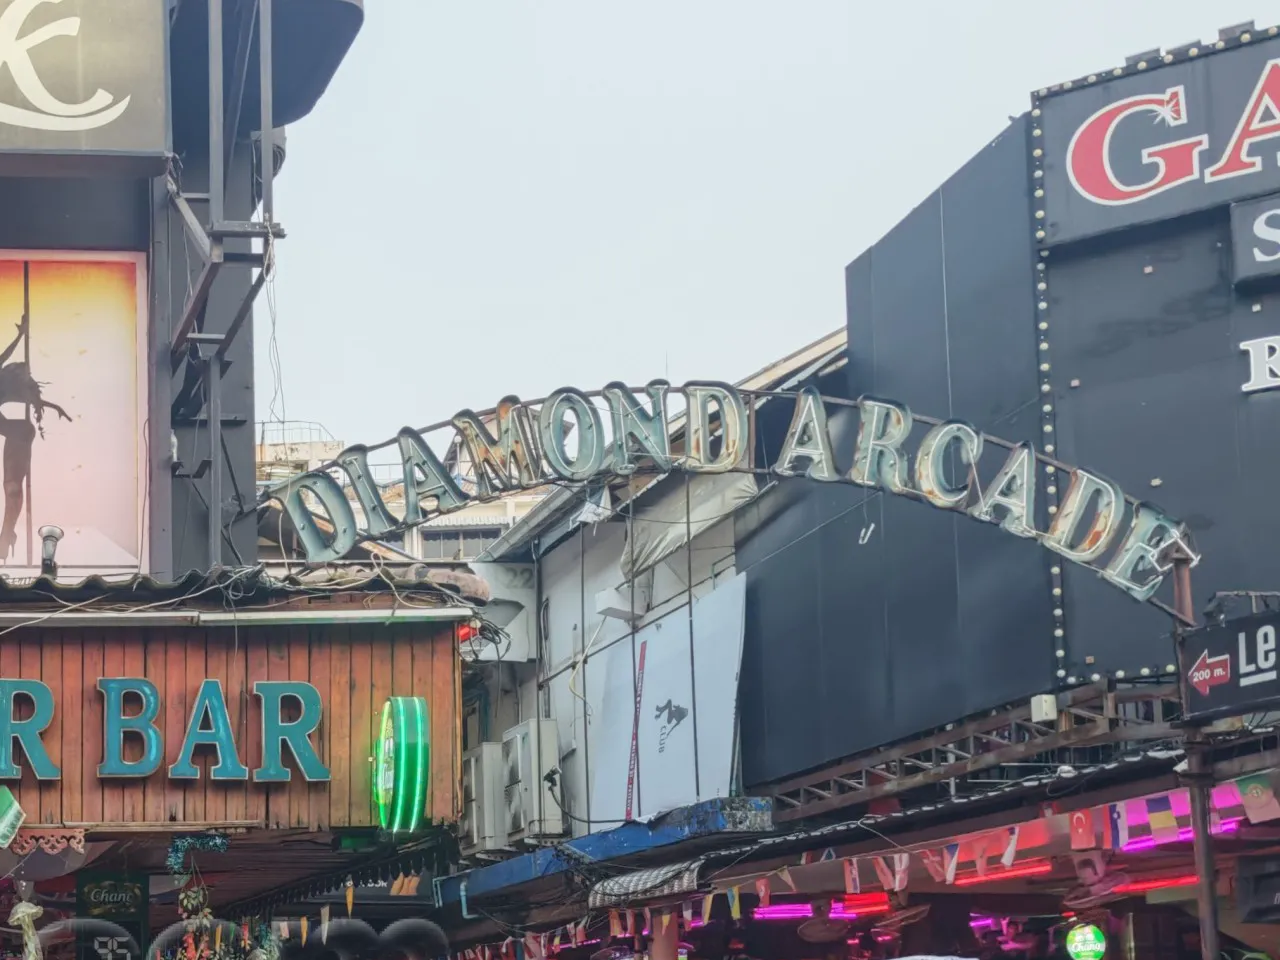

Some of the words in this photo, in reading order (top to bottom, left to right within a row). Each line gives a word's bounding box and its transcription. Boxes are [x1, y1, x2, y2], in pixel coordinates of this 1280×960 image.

[269, 380, 748, 566] DIAMOND
[773, 385, 1202, 602] ARCADE
[1193, 669, 1210, 682] 200
[96, 676, 331, 783] BAR
[659, 724, 667, 754] CLUB
